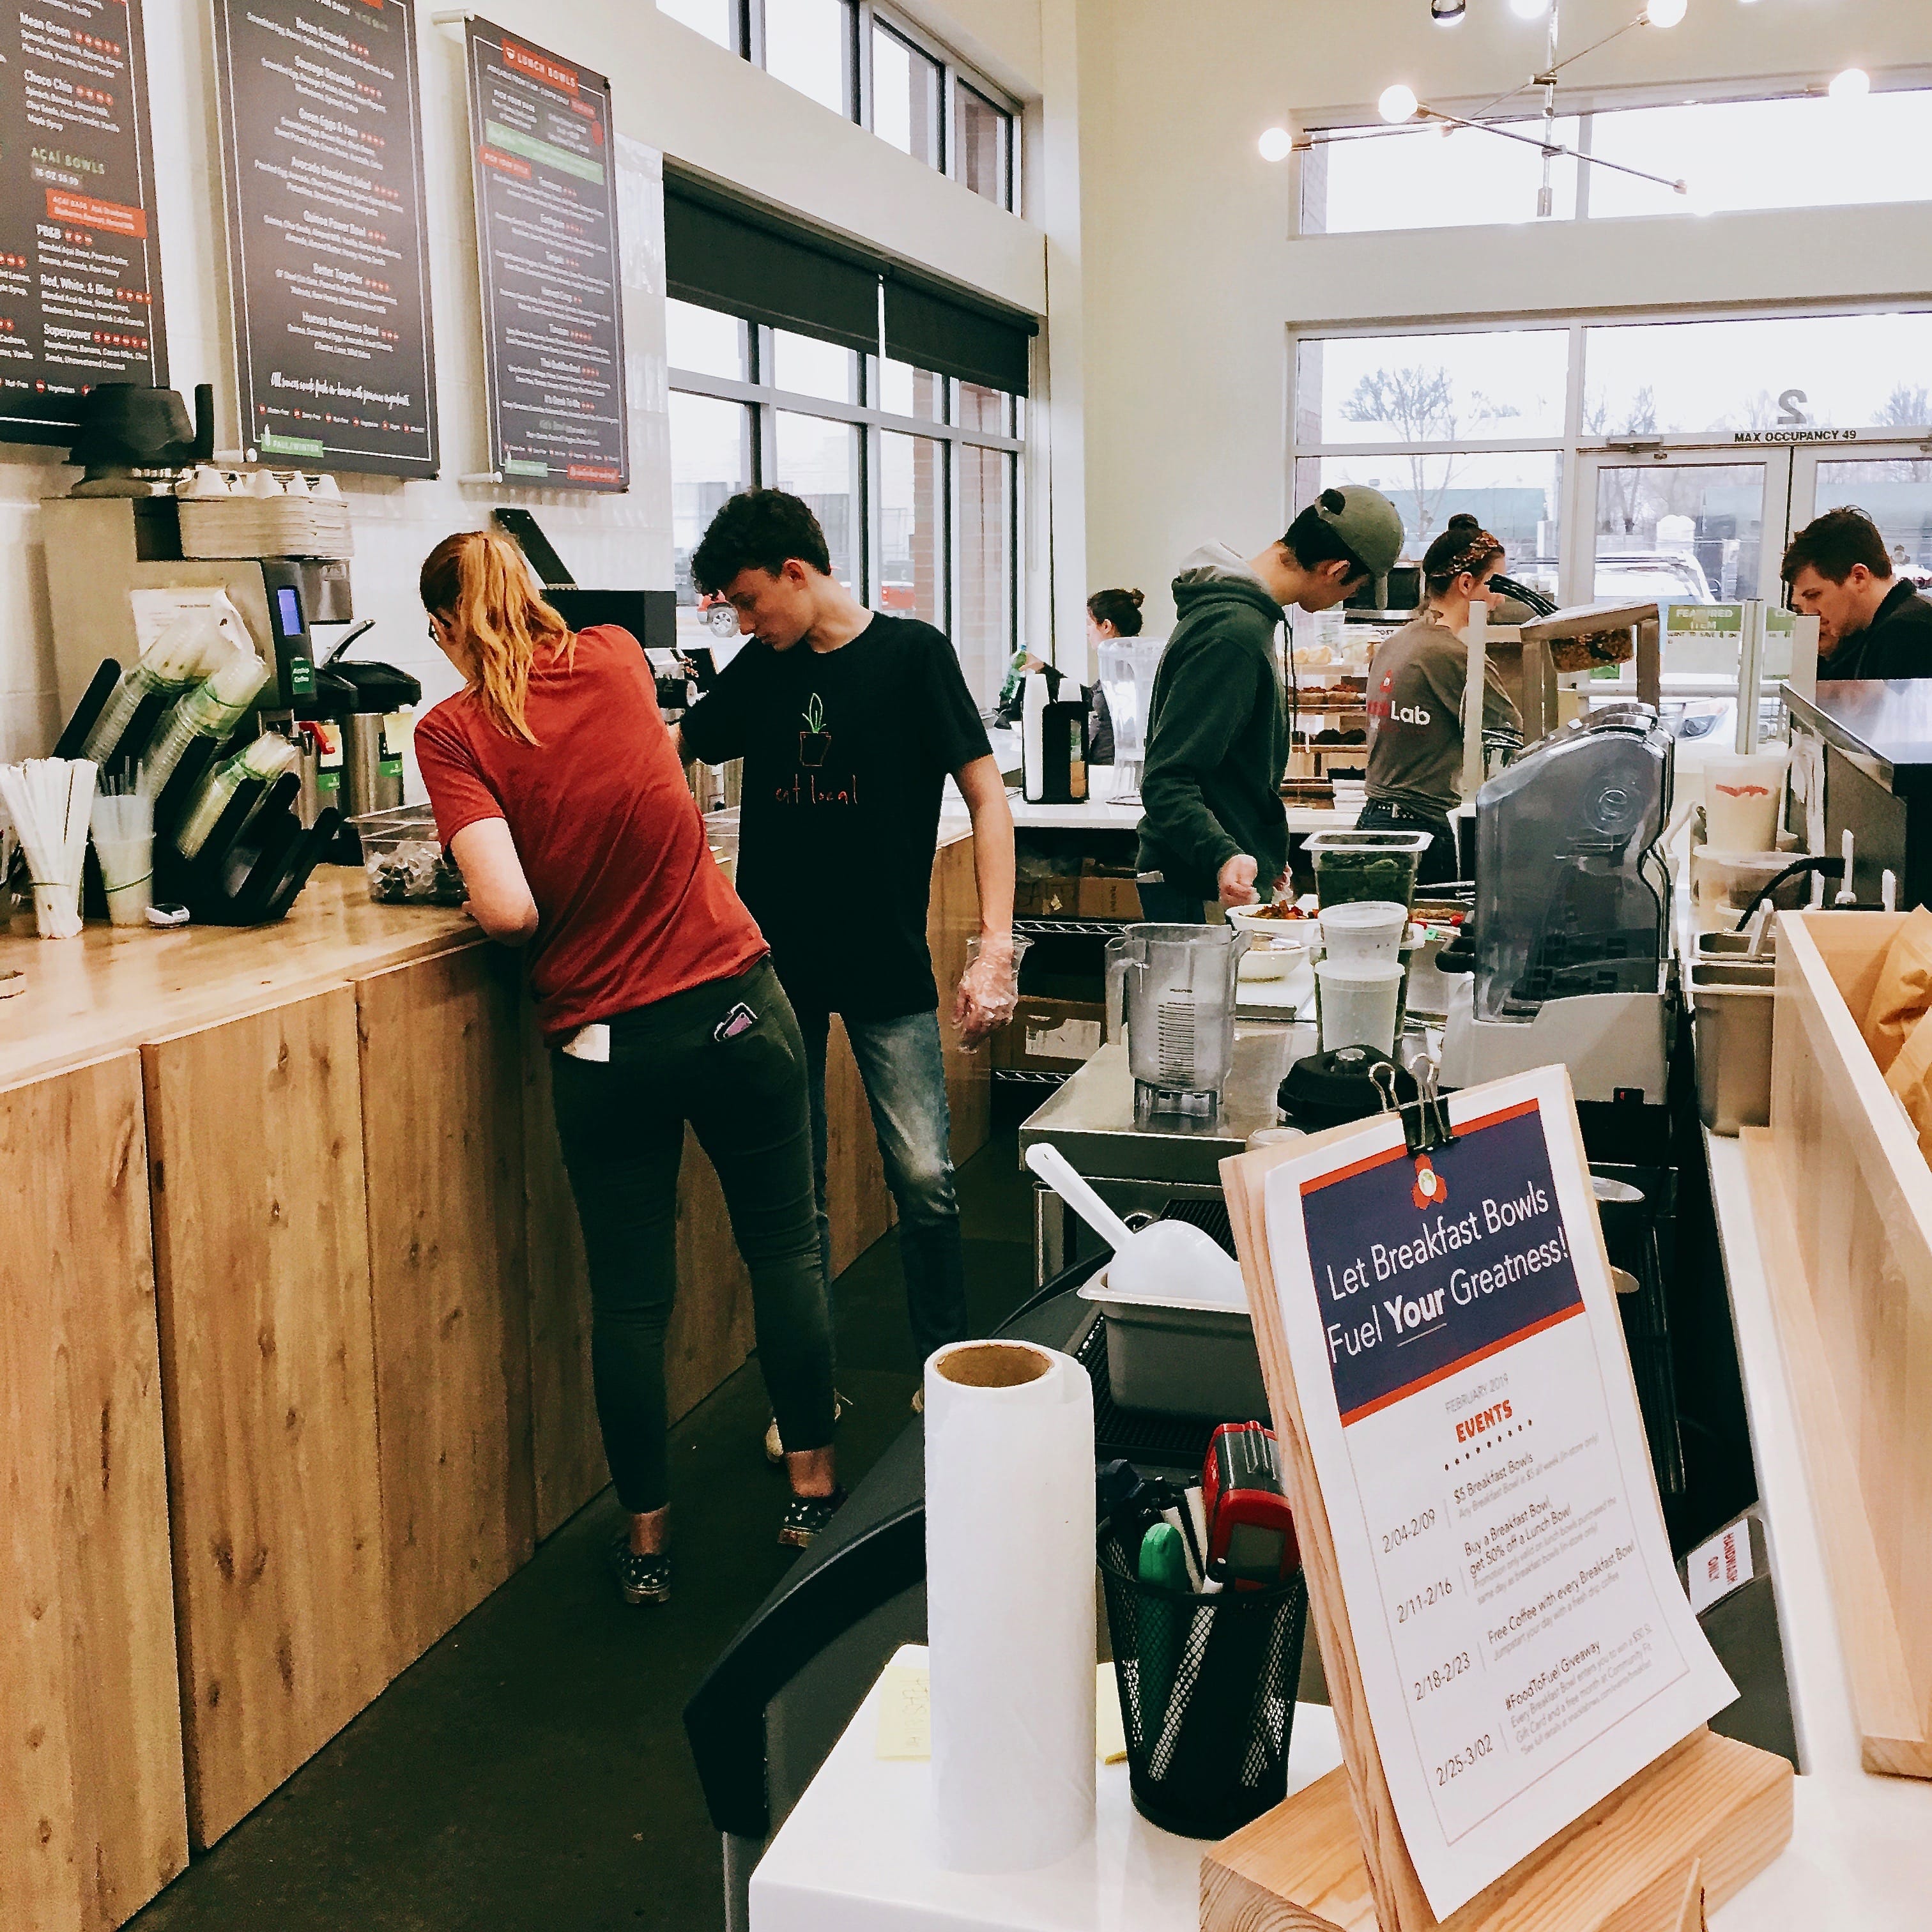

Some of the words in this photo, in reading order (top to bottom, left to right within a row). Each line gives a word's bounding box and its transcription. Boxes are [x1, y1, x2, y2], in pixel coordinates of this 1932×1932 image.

[45, 20, 70, 38] Green
[517, 54, 545, 73] LUNCH
[548, 67, 575, 88] BOWLS
[65, 155, 105, 174] BOWLS
[40, 273, 59, 289] Red,
[95, 283, 113, 296] Blue
[43, 323, 91, 340] Superpower
[1734, 433, 1761, 442] MAX
[1765, 431, 1839, 441] OCCUPANCY
[1842, 430, 1857, 440] 49
[1390, 700, 1430, 725] Lab
[811, 774, 857, 804] local
[1327, 1264, 1370, 1301] Let
[1370, 1215, 1482, 1282] Breakfast
[1482, 1181, 1549, 1234] Bowls
[1326, 1305, 1383, 1363] Fuel
[1383, 1287, 1445, 1334] Your
[1450, 1226, 1568, 1306] Greatness!
[1445, 1384, 1487, 1412] FEBRUARY
[1489, 1372, 1508, 1392] 2019
[1455, 1399, 1512, 1443] EVENTS
[1466, 1467, 1506, 1496] Breakfast
[1508, 1453, 1533, 1474] Bowls
[1382, 1508, 1434, 1553] 2/04-2/09
[1464, 1542, 1481, 1556] Buy
[1483, 1535, 1489, 1545] a
[1490, 1511, 1528, 1541] Breakfast
[1470, 1558, 1485, 1579] get
[1485, 1545, 1505, 1565] 50%
[1506, 1535, 1517, 1552] off
[1519, 1534, 1525, 1545] a
[1525, 1517, 1549, 1540] Lunch
[1550, 1504, 1570, 1524] Bowl
[1708, 1556, 1720, 1583] ONLY
[1723, 1532, 1738, 1586] HANDWASH
[1397, 1578, 1452, 1623] 2/11-2/16
[1487, 1625, 1507, 1644] Free
[1508, 1606, 1537, 1630] Coffee
[1538, 1592, 1556, 1611] with
[1557, 1580, 1579, 1599] every
[1579, 1554, 1615, 1584] Breakfast
[1614, 1540, 1634, 1560] Bowl
[1414, 1652, 1469, 1700] 2/18-2/23
[1561, 1641, 1600, 1673] Giveaway
[1607, 1650, 1643, 1678] Community
[1436, 1734, 1492, 1786] 2/25-3/02
